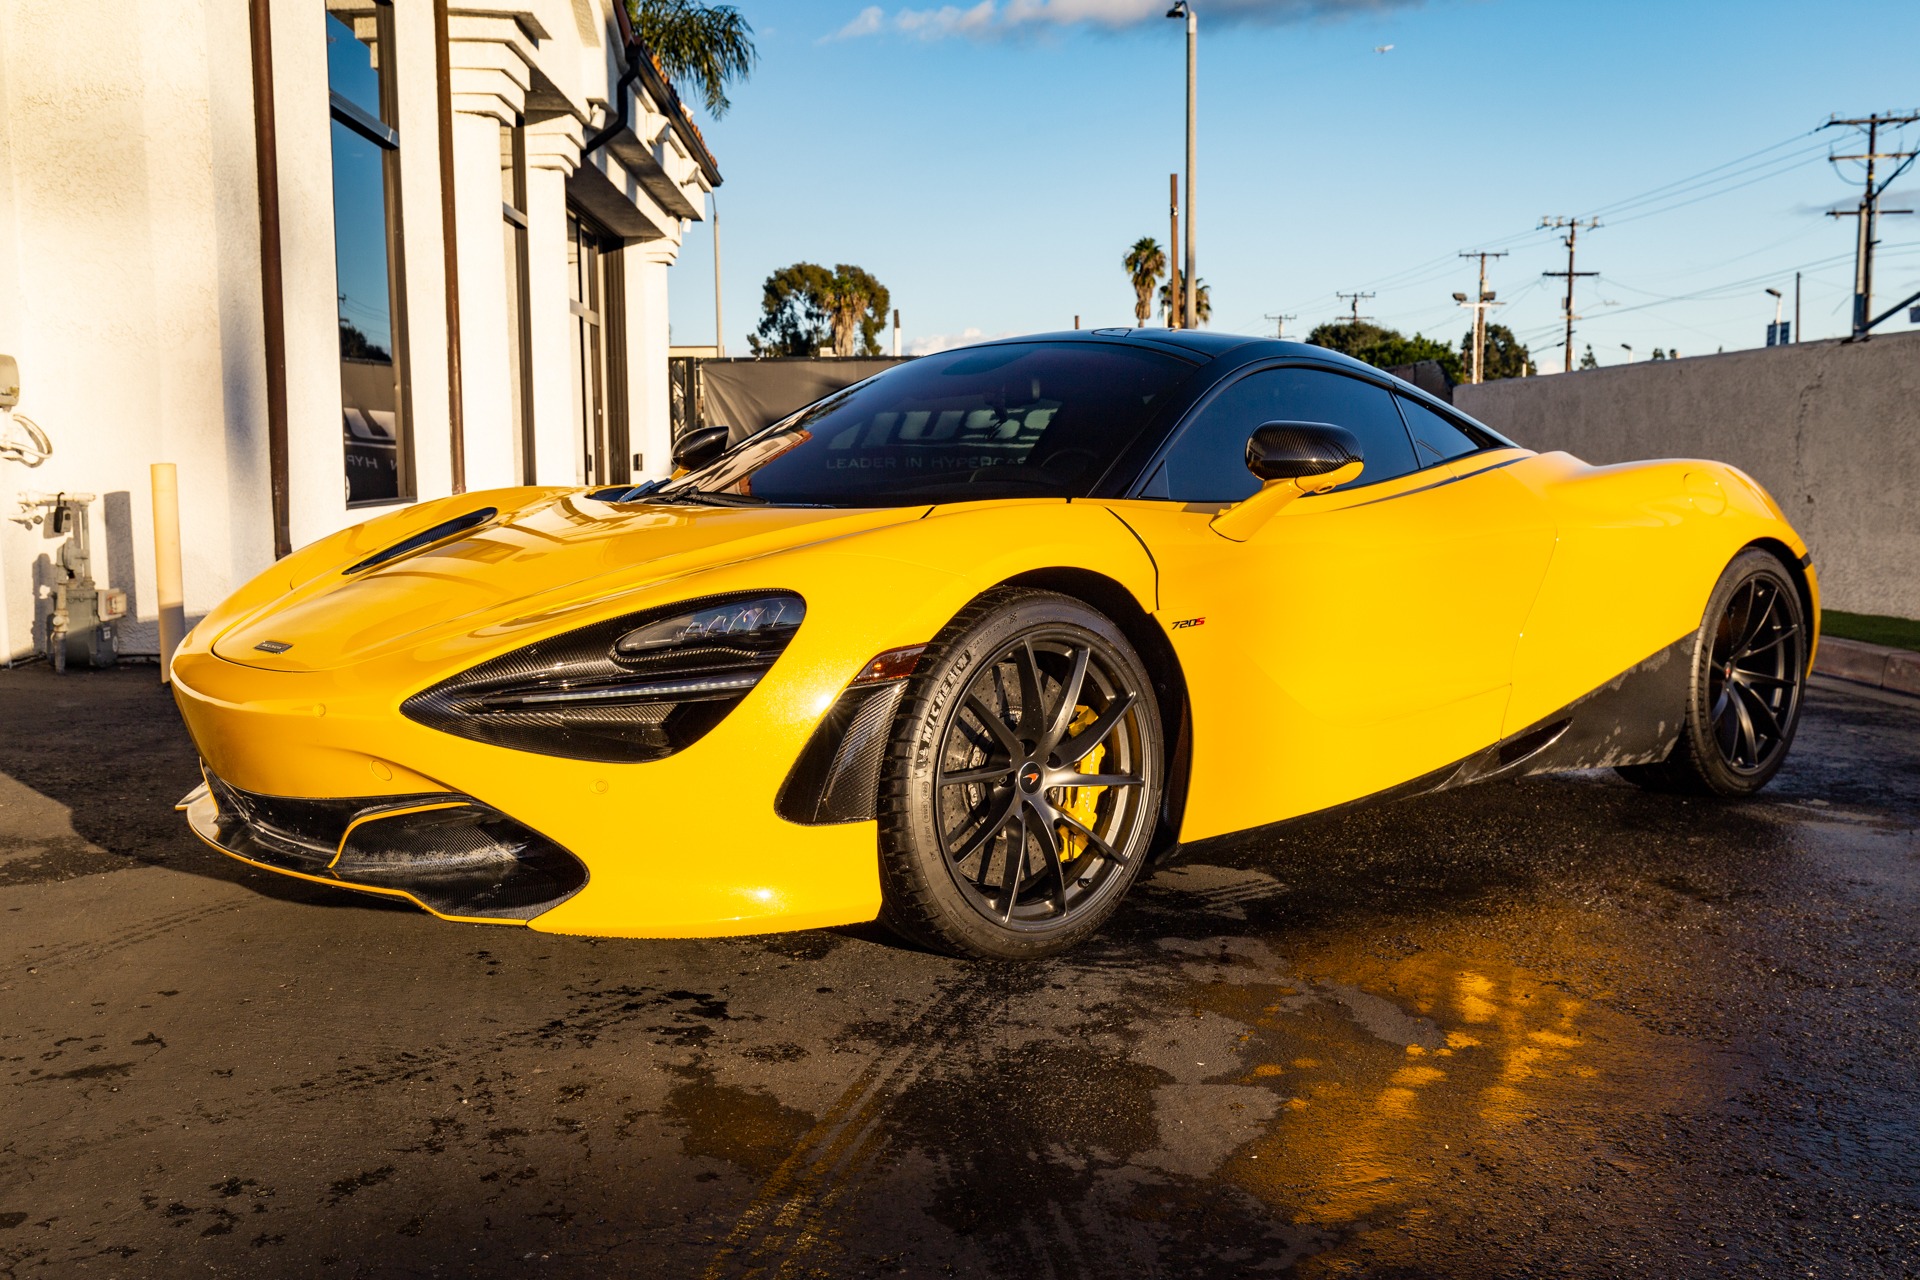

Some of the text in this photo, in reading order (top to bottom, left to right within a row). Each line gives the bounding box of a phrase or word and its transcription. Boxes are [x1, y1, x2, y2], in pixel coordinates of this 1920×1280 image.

[826, 457, 896, 469] LEADER
[906, 456, 922, 468] IN
[1172, 617, 1206, 630] 720S
[922, 652, 969, 743] MICHELIN
